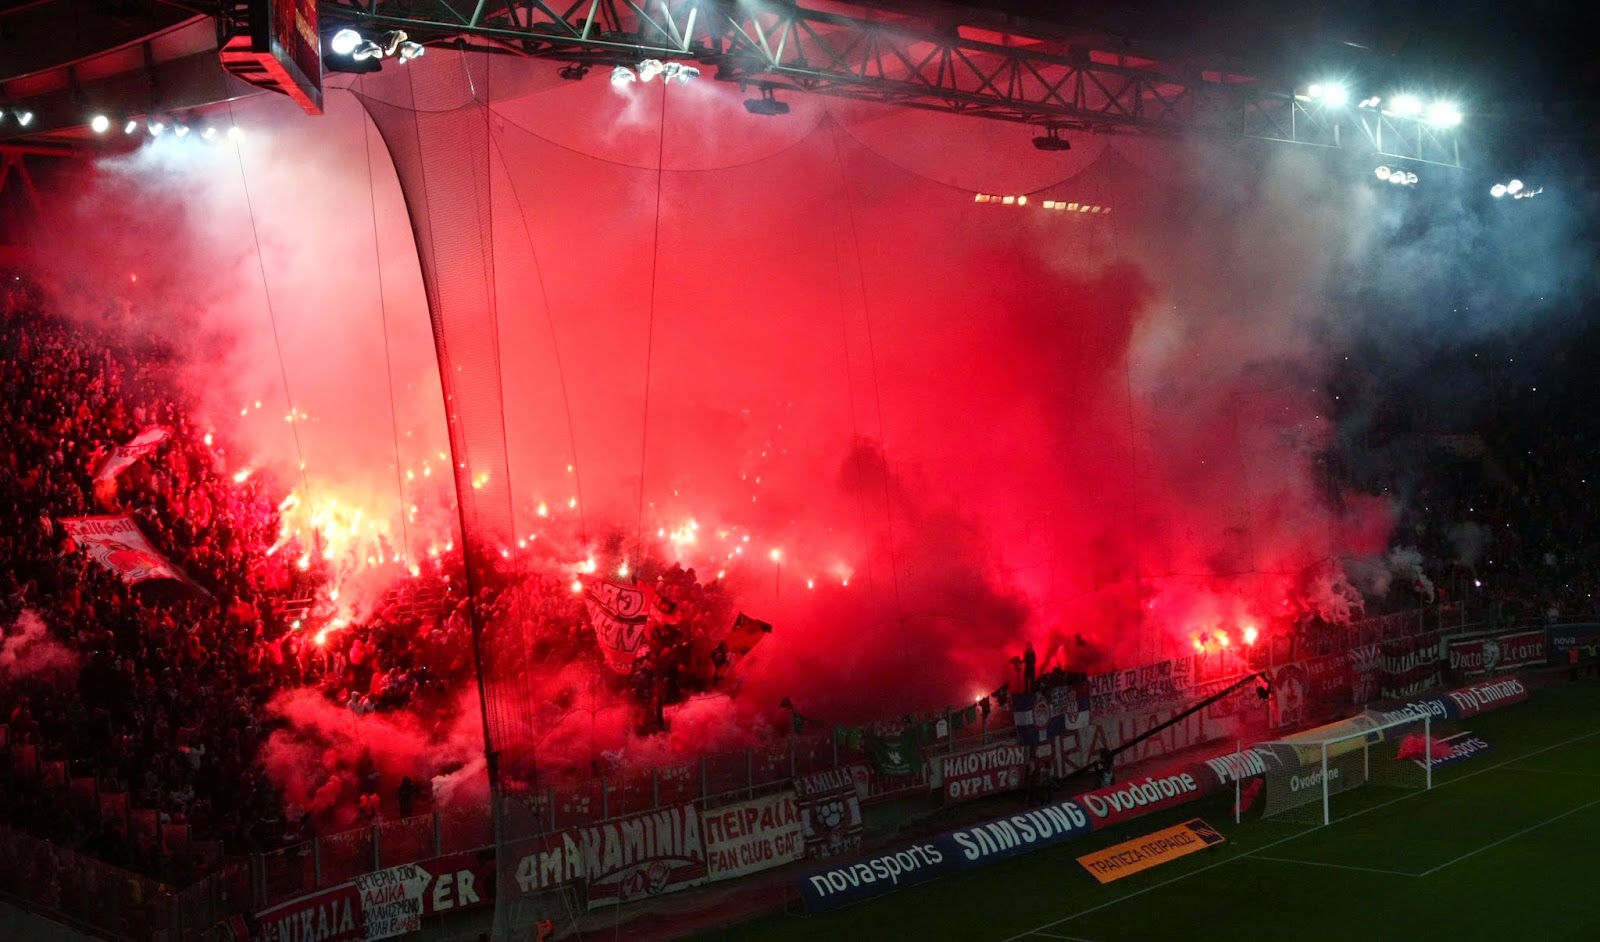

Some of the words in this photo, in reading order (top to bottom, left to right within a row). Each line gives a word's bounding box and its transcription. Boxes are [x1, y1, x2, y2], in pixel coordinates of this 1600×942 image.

[1553, 636, 1576, 645] nova
[1451, 690, 1479, 711] Fly
[1469, 679, 1524, 704] Emirates
[1108, 773, 1198, 812] vodafone
[579, 801, 705, 884] KAMINIA
[708, 847, 739, 873] FAN
[740, 839, 773, 866] CLUB
[774, 830, 800, 856] GAT
[952, 801, 1087, 861] SAMSUNG
[809, 844, 944, 897] novasports
[1088, 848, 1148, 875] ΤΡΑΠΕΖΑ
[1141, 831, 1197, 857] ΠΕΙΡΑΙΩΣ
[364, 883, 406, 906] ΑΔΙΚΑ
[278, 896, 356, 942] NIKAIA
